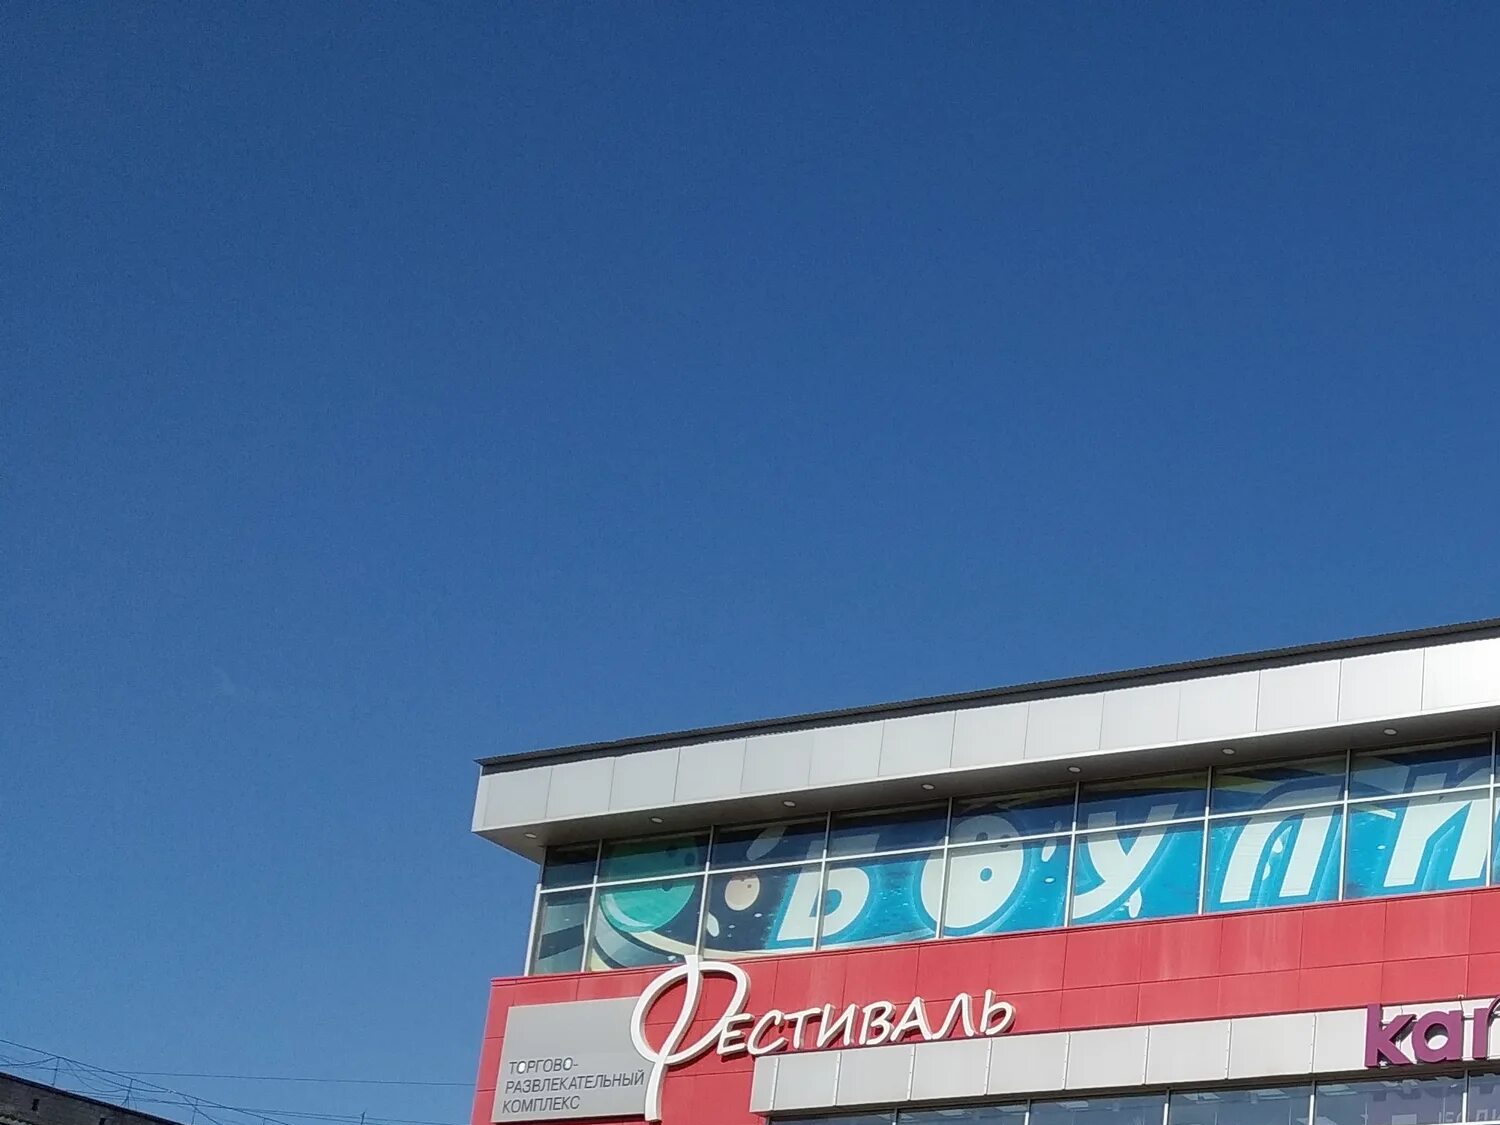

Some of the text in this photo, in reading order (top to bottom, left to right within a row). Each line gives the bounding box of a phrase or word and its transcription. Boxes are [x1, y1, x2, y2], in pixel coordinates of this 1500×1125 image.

[509, 1057, 579, 1075] ТОРГОВО-
[505, 1069, 645, 1094] РАЗВЛЕКАТЕЛЬНЫЙ
[502, 1096, 581, 1113] КОМПЛЕКС
